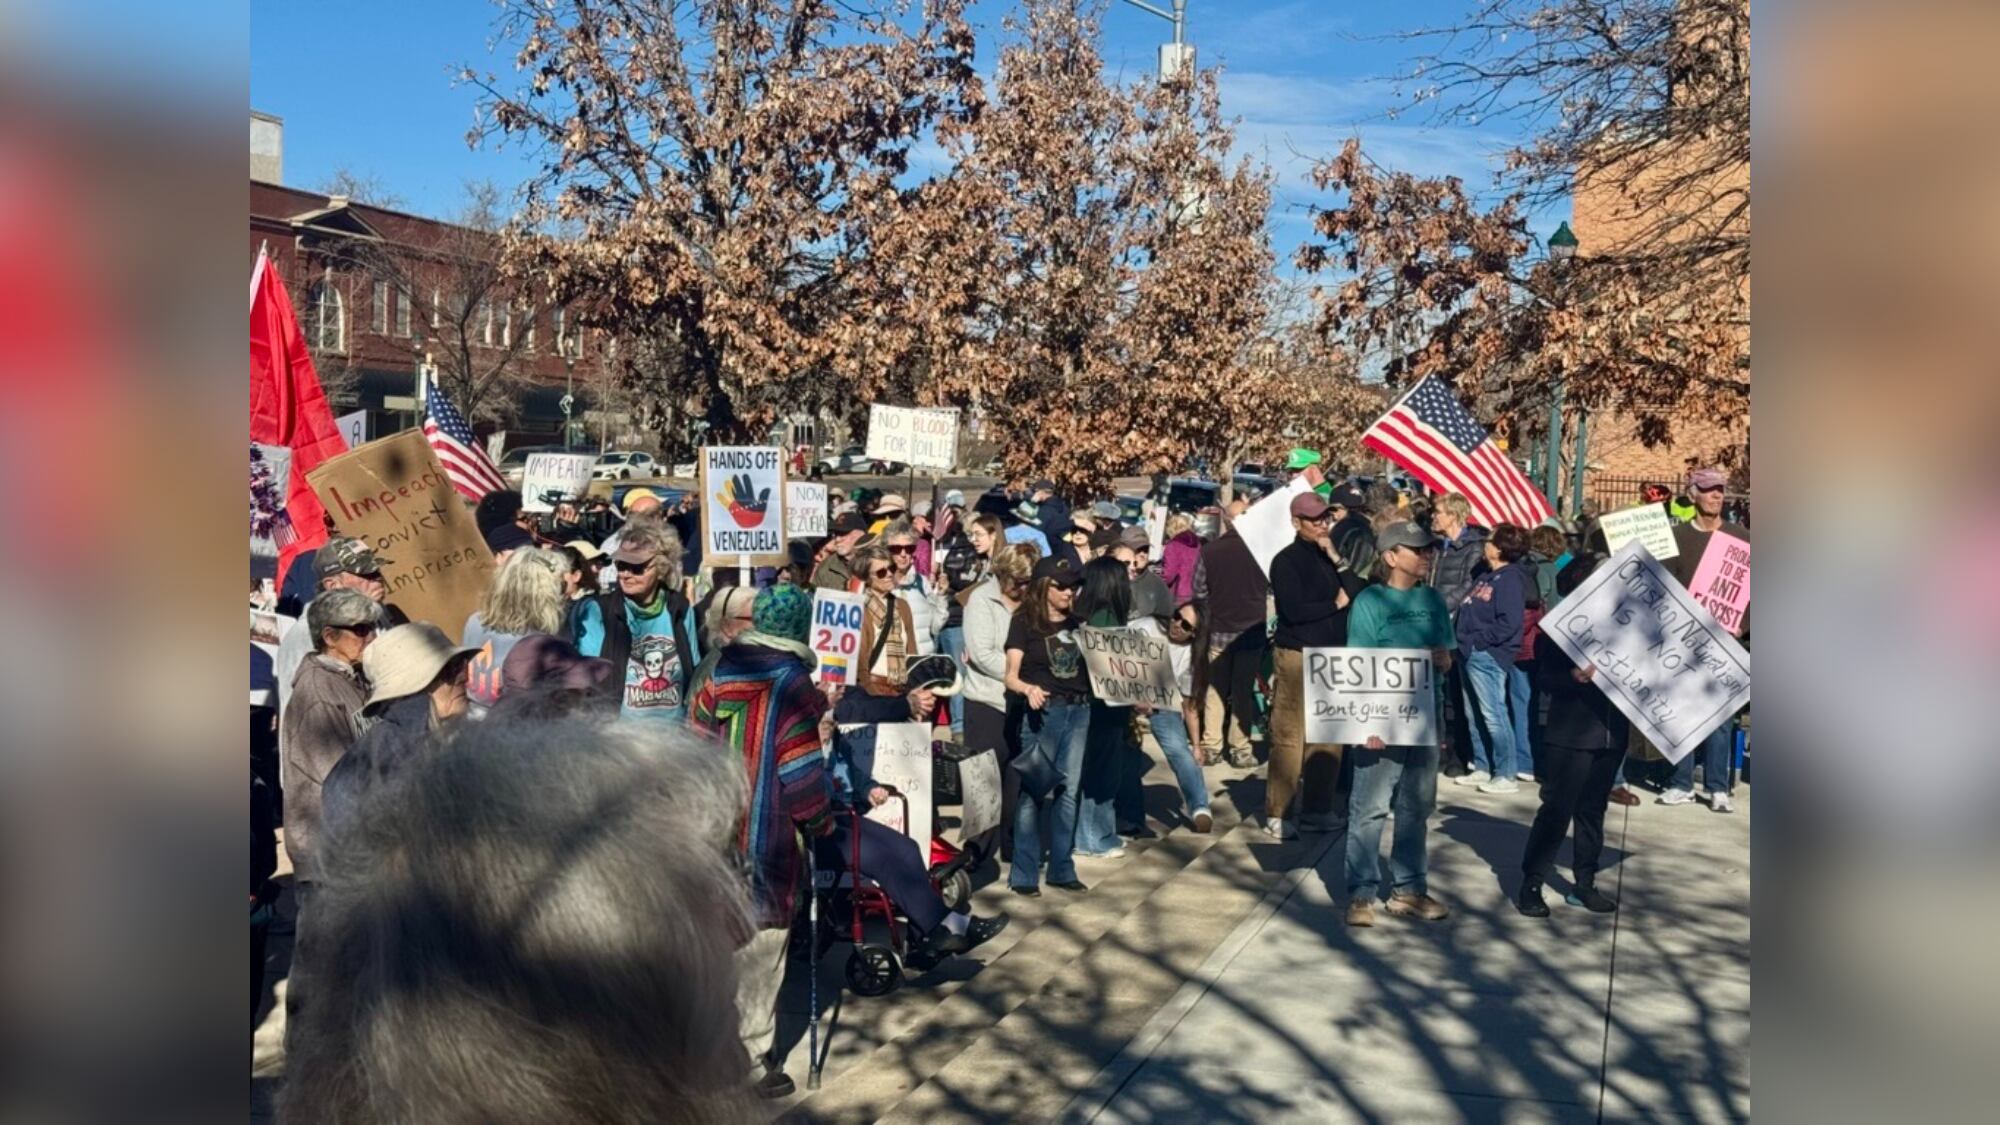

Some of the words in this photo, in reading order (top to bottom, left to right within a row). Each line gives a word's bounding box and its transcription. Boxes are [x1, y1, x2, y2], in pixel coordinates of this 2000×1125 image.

[878, 411, 901, 429] NO
[912, 416, 950, 436] BLOOD
[884, 435, 907, 453] FOR
[529, 456, 593, 479] IMPEACH
[709, 451, 752, 470] HANDS
[755, 451, 778, 470] OFF
[329, 461, 449, 522] Impeach
[796, 486, 825, 501] NOW
[713, 531, 779, 551] VENEZUELA
[383, 546, 476, 595] Imprison
[1719, 560, 1733, 577] TO
[1732, 566, 1747, 583] BE
[1708, 576, 1741, 604] ANTI
[816, 600, 862, 631] IRAQ
[816, 629, 856, 655] 2.0
[1084, 629, 1165, 660] DEMOCRACY
[1109, 656, 1149, 681] NOT
[1309, 653, 1430, 691] RESIST!
[1567, 614, 1678, 726] Christianity
[1648, 640, 1697, 679] NOT
[1094, 675, 1174, 706] MONARCHY
[1356, 703, 1390, 723] give
[1398, 704, 1419, 724] up
